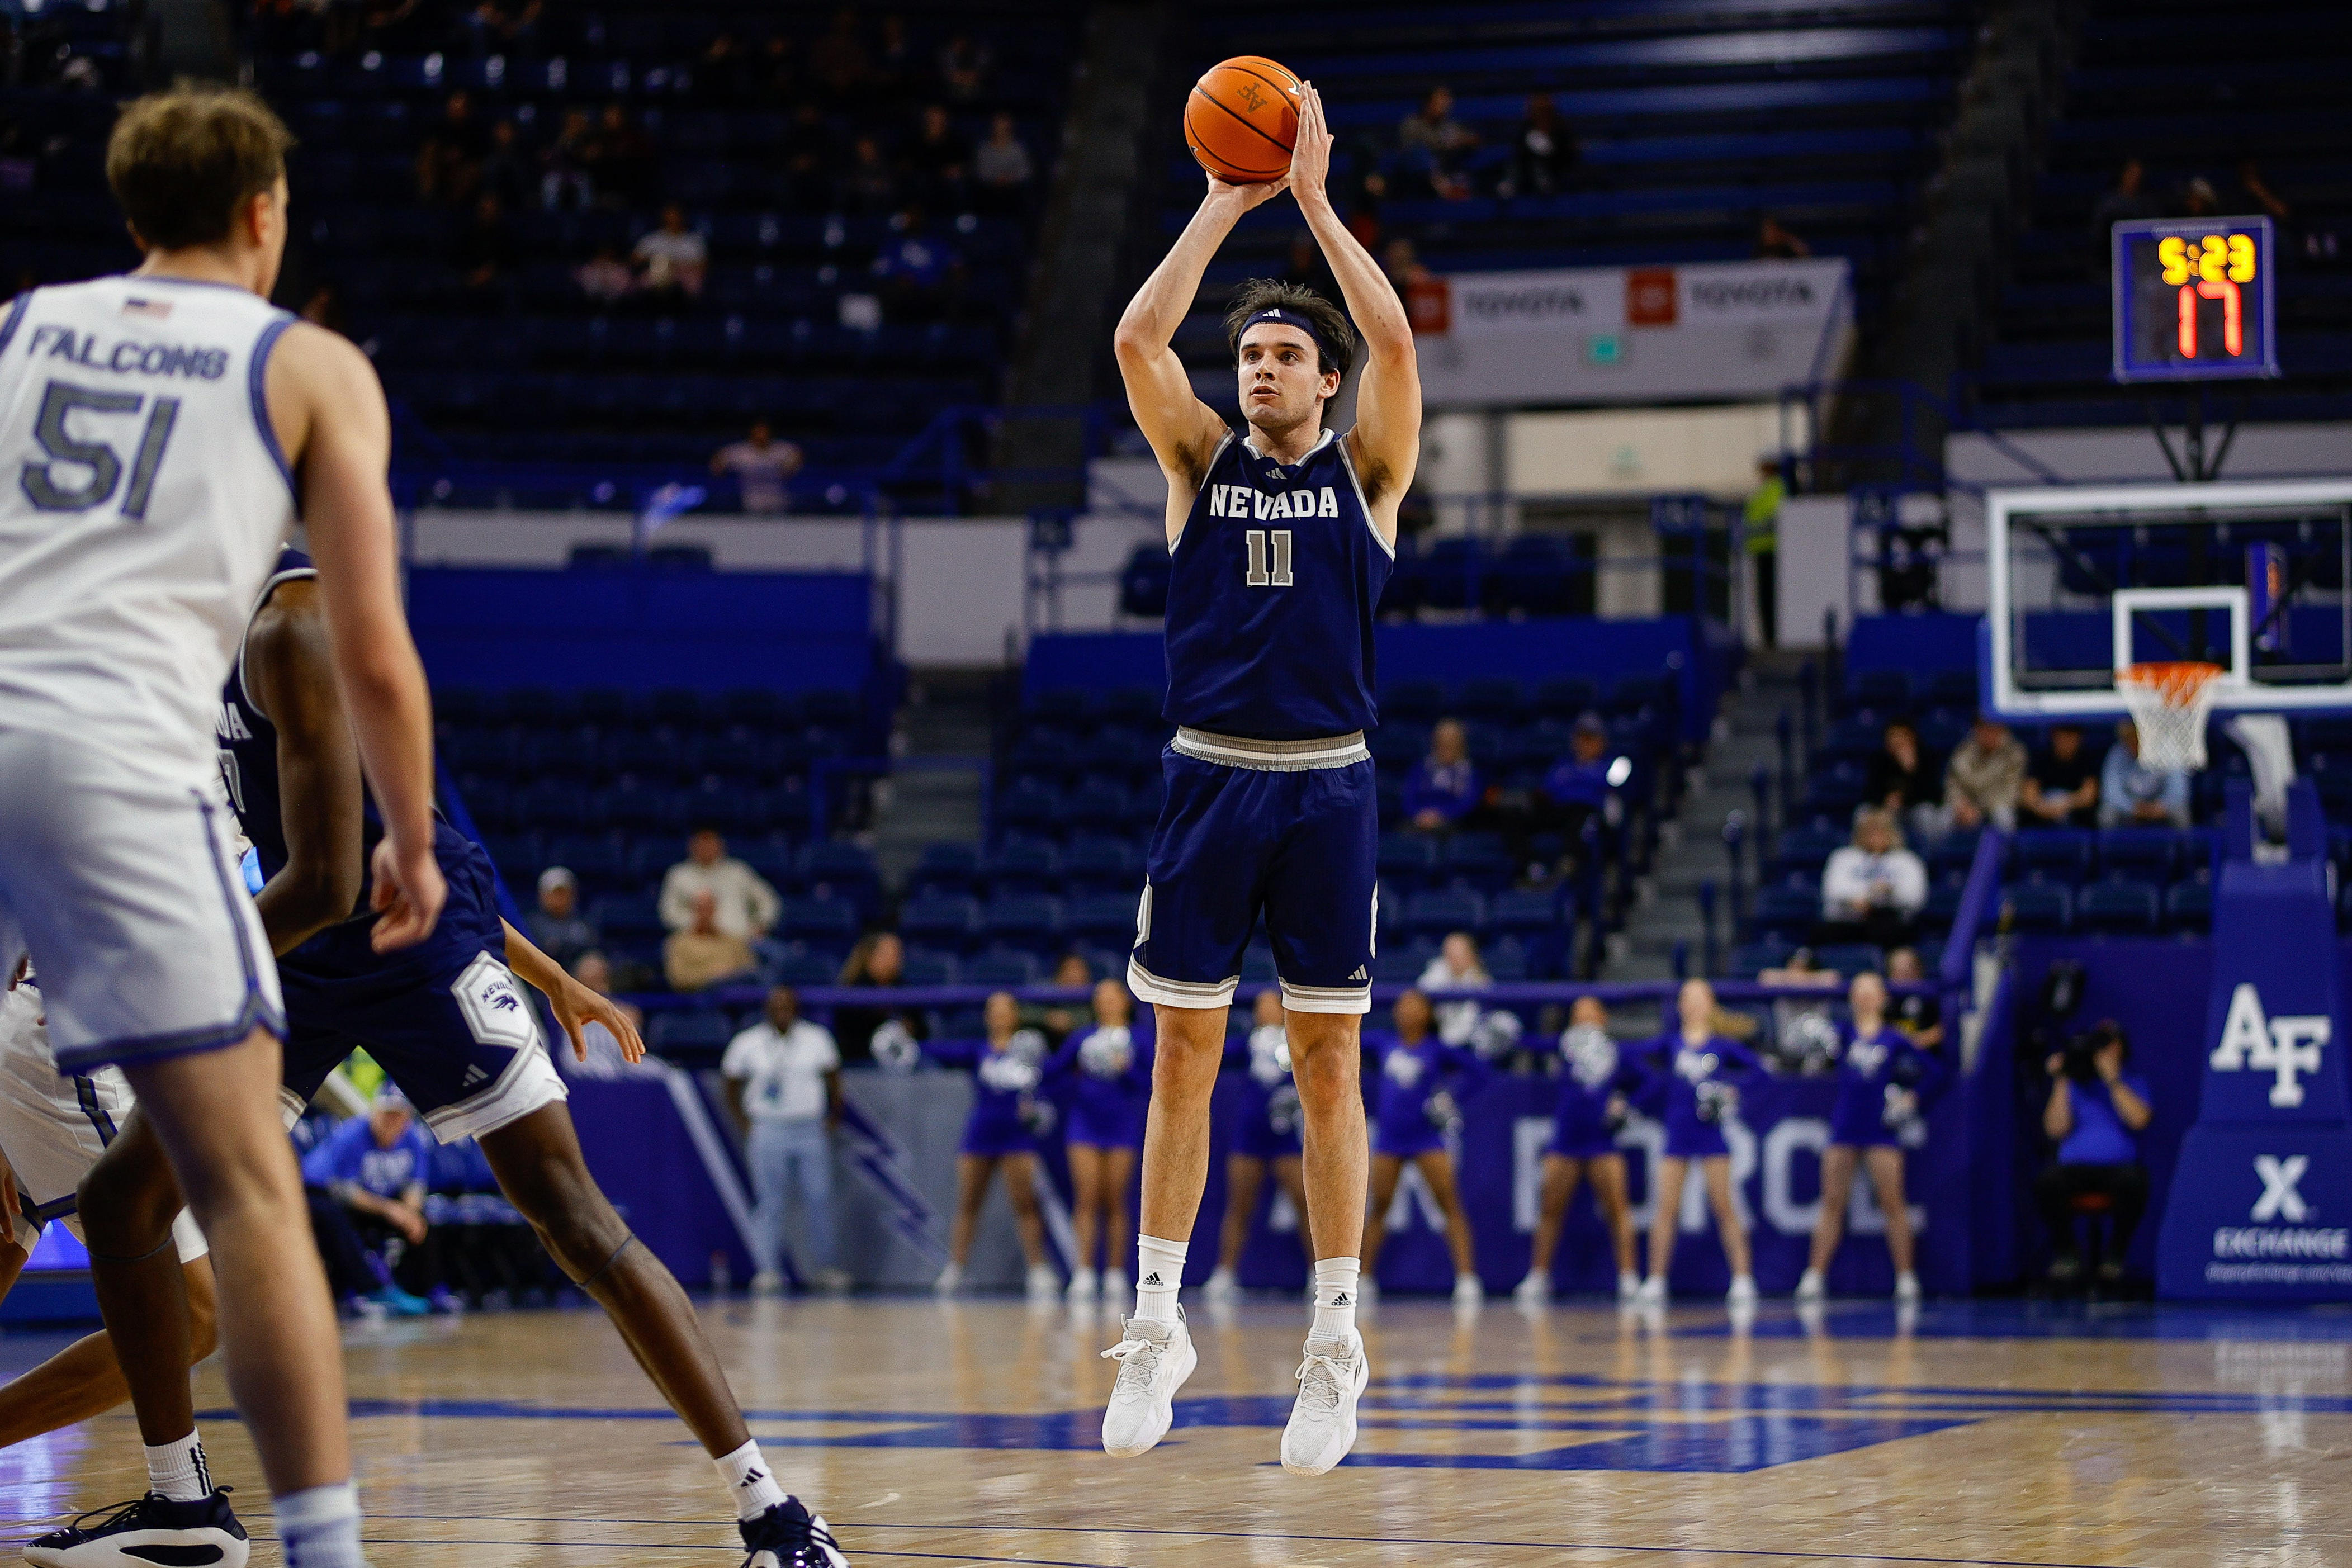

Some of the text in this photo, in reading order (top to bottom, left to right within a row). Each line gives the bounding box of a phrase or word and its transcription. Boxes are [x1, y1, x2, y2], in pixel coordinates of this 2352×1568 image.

[2158, 233, 2256, 286] 5:23
[2178, 279, 2242, 359] 17
[28, 323, 230, 381] FALCONS
[20, 378, 182, 521] 51
[1209, 484, 1338, 520] NEVADA
[1246, 530, 1293, 586] 11
[2209, 982, 2331, 1109] AF
[2249, 1153, 2310, 1223] X
